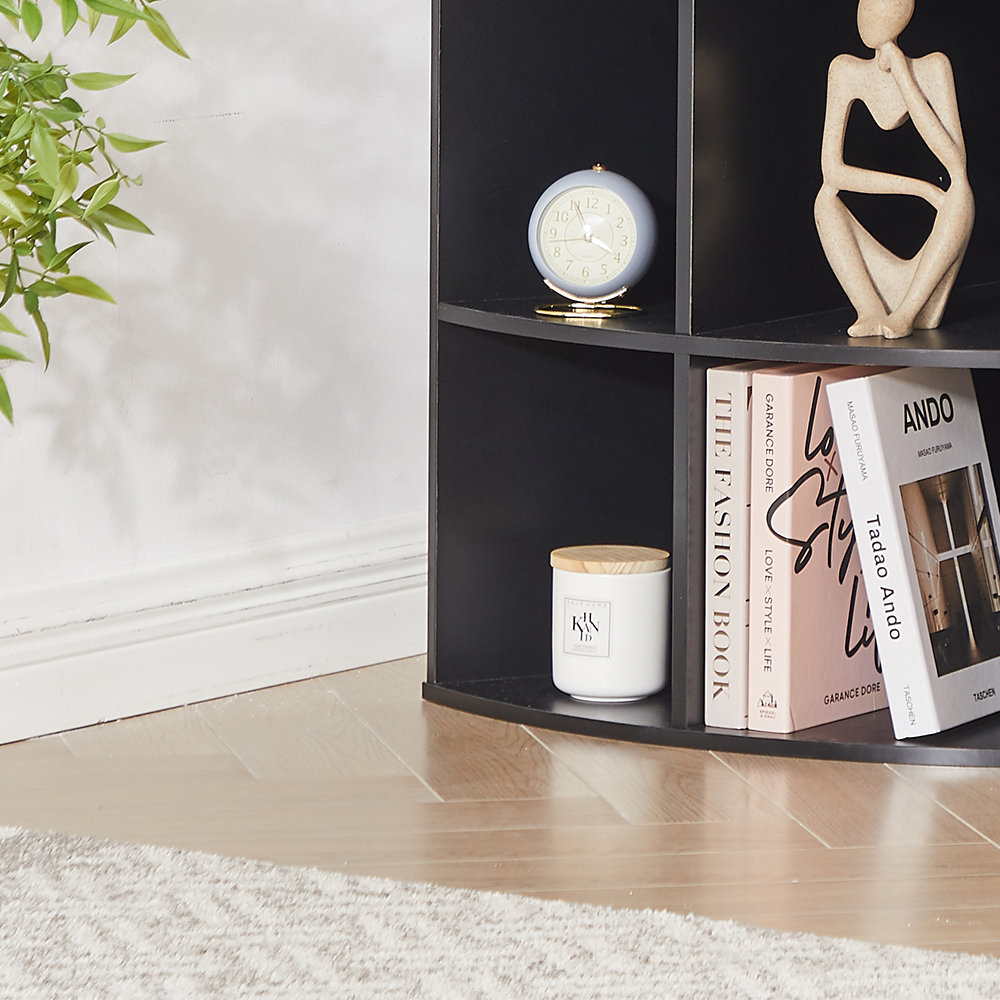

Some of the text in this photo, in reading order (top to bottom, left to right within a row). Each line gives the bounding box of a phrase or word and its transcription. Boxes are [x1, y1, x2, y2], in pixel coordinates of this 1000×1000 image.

[586, 197, 599, 210] 12
[607, 203, 611, 215] 1
[556, 211, 569, 223] 10
[617, 216, 624, 228] 2
[550, 228, 557, 240] 9
[620, 235, 627, 247] 3
[553, 247, 560, 258] 8
[613, 252, 621, 263] 4
[566, 259, 573, 270] 7
[601, 263, 608, 275] 5
[582, 267, 589, 278] 6
[804, 376, 835, 461] Lo
[903, 393, 955, 434] ANDO
[765, 393, 774, 493] GARANCE DORE
[846, 400, 868, 481] MASAO FURUYAMA
[917, 447, 931, 457] MASAO
[712, 392, 733, 701] THE FASHION BOOK
[764, 549, 773, 582] LOVE
[867, 514, 901, 640] Tadao Ando
[764, 596, 773, 634] STYLE
[763, 649, 772, 673] LIFE
[823, 682, 882, 705] GARANCE DORE
[973, 687, 996, 702] TASCHEN
[903, 685, 917, 726] TASCHEN
